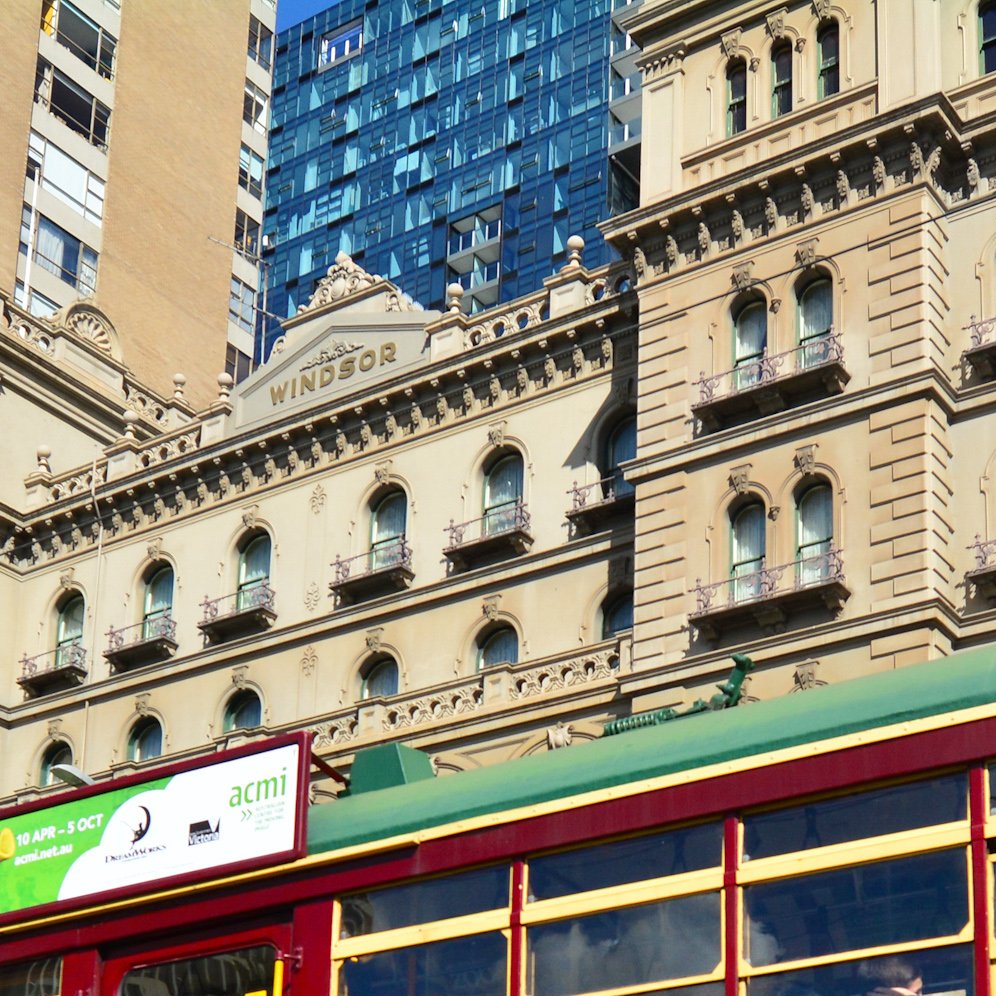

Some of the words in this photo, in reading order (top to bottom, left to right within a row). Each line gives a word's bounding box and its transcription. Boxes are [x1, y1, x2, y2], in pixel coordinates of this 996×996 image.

[269, 341, 397, 406] WINDSOR
[229, 767, 287, 808] acmi
[16, 832, 31, 847] 10
[32, 825, 56, 844] APR
[67, 820, 76, 835] 5
[77, 813, 104, 832] OCT
[14, 843, 74, 866] acmi.net.au
